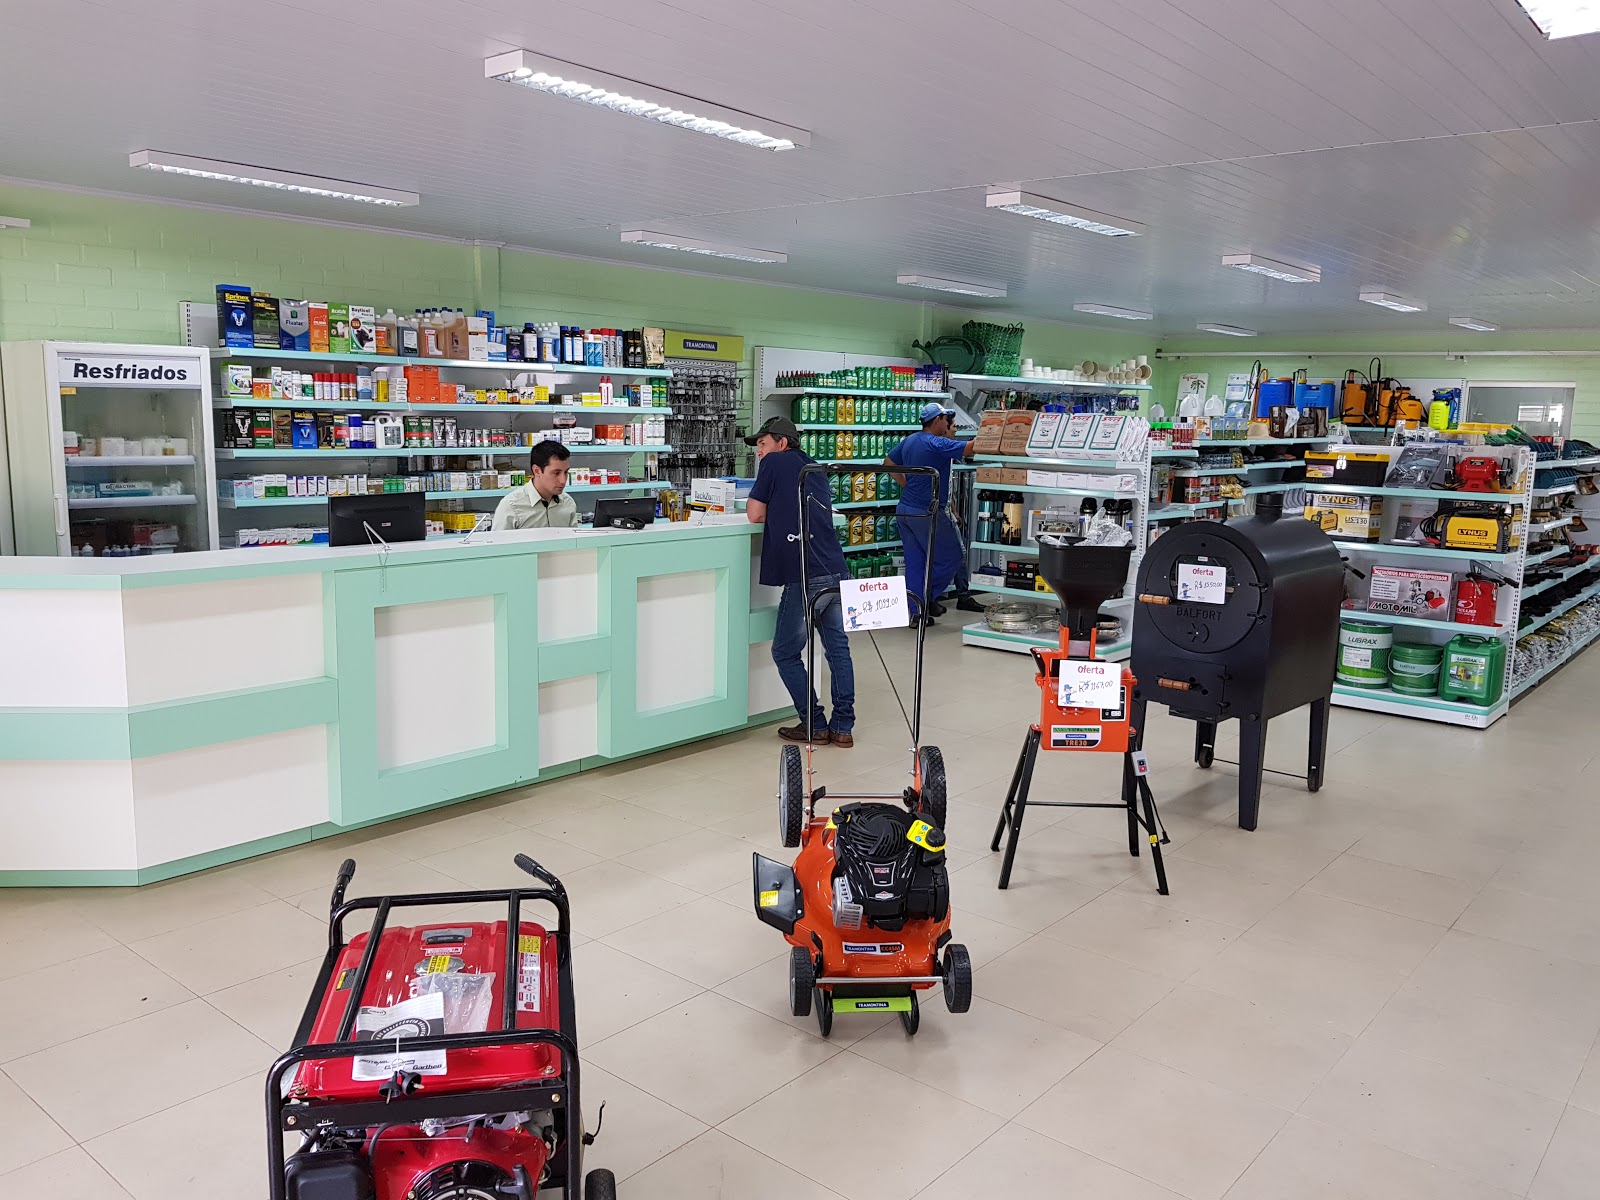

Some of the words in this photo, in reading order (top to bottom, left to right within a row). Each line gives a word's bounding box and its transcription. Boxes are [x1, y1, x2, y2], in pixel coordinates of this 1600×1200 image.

[225, 293, 250, 302] Eprinex
[686, 341, 716, 350] TRAMONTINA
[73, 363, 187, 380] Resfriados
[1319, 495, 1358, 504] LYNUS
[1192, 568, 1214, 576] Oferta
[859, 582, 888, 592] Oferta
[1369, 601, 1417, 614] MOTOMIL
[1176, 607, 1222, 621] BALFORT
[1347, 636, 1377, 645] LUBRAX
[1078, 665, 1105, 674] Oferta
